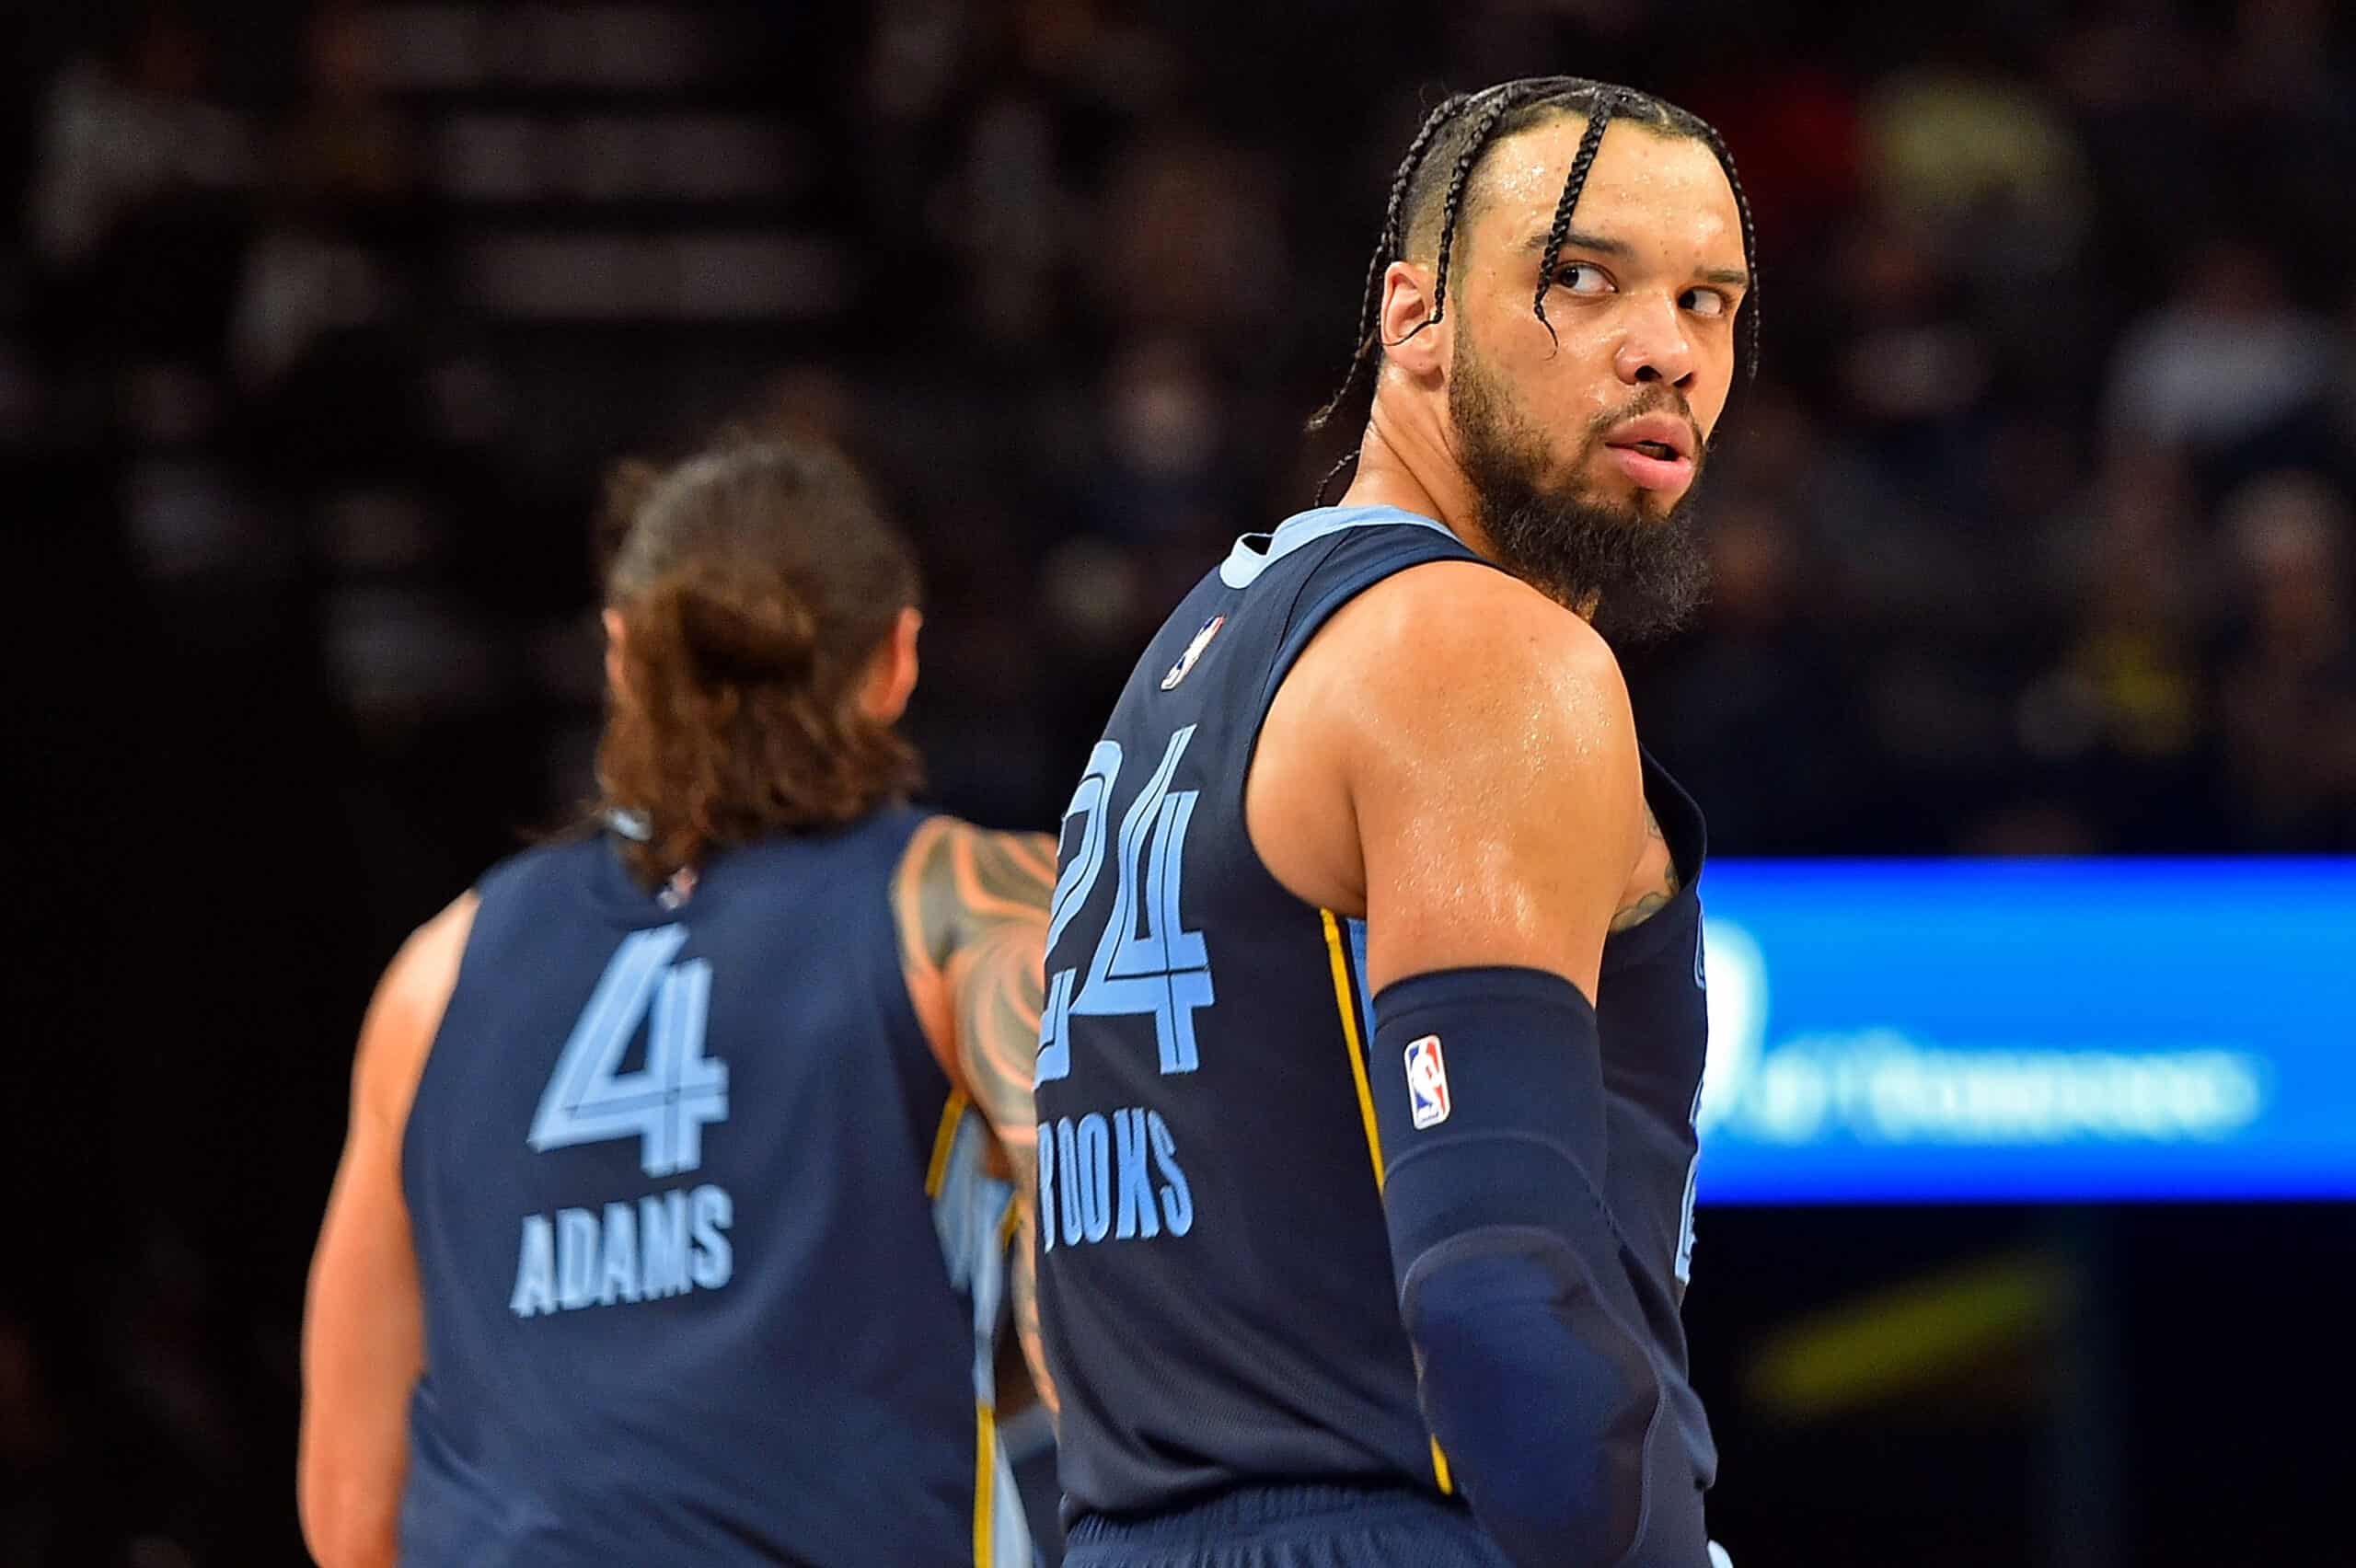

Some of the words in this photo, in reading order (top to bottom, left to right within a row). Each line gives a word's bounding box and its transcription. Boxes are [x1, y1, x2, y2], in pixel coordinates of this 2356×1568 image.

[1034, 724, 1214, 1089] 24
[527, 923, 729, 1176] 4
[510, 1184, 733, 1318] ADAMS
